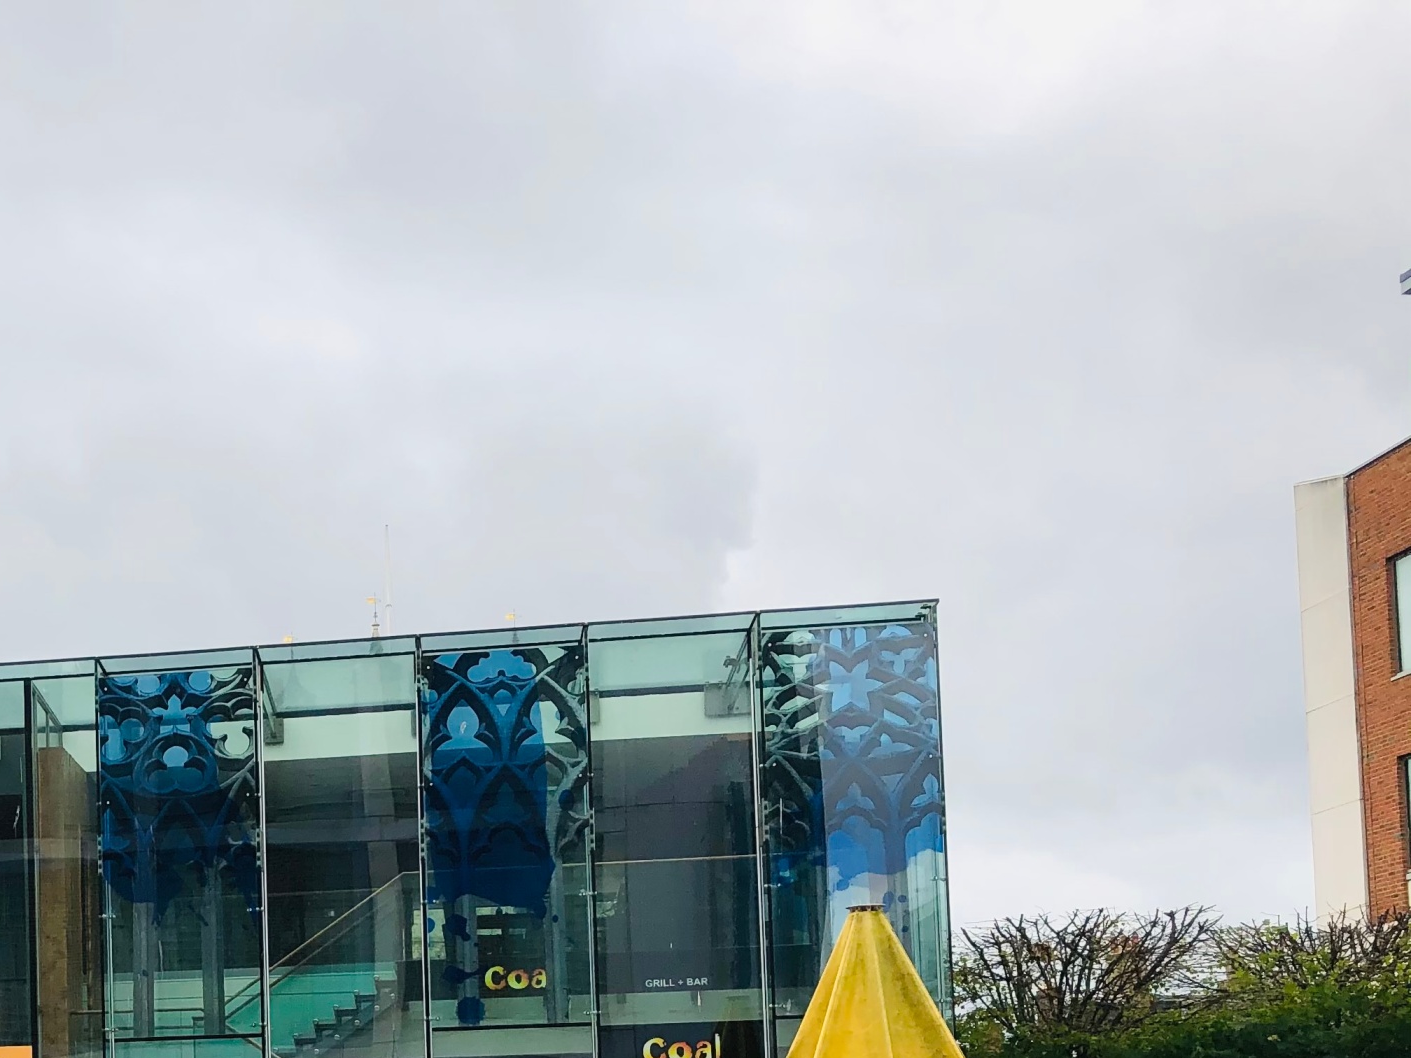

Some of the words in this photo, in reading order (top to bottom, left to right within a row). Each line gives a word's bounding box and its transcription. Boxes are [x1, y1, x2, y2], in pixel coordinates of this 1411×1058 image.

[484, 965, 547, 990] Coa
[645, 979, 675, 988] GRILL
[686, 977, 708, 987] BAR
